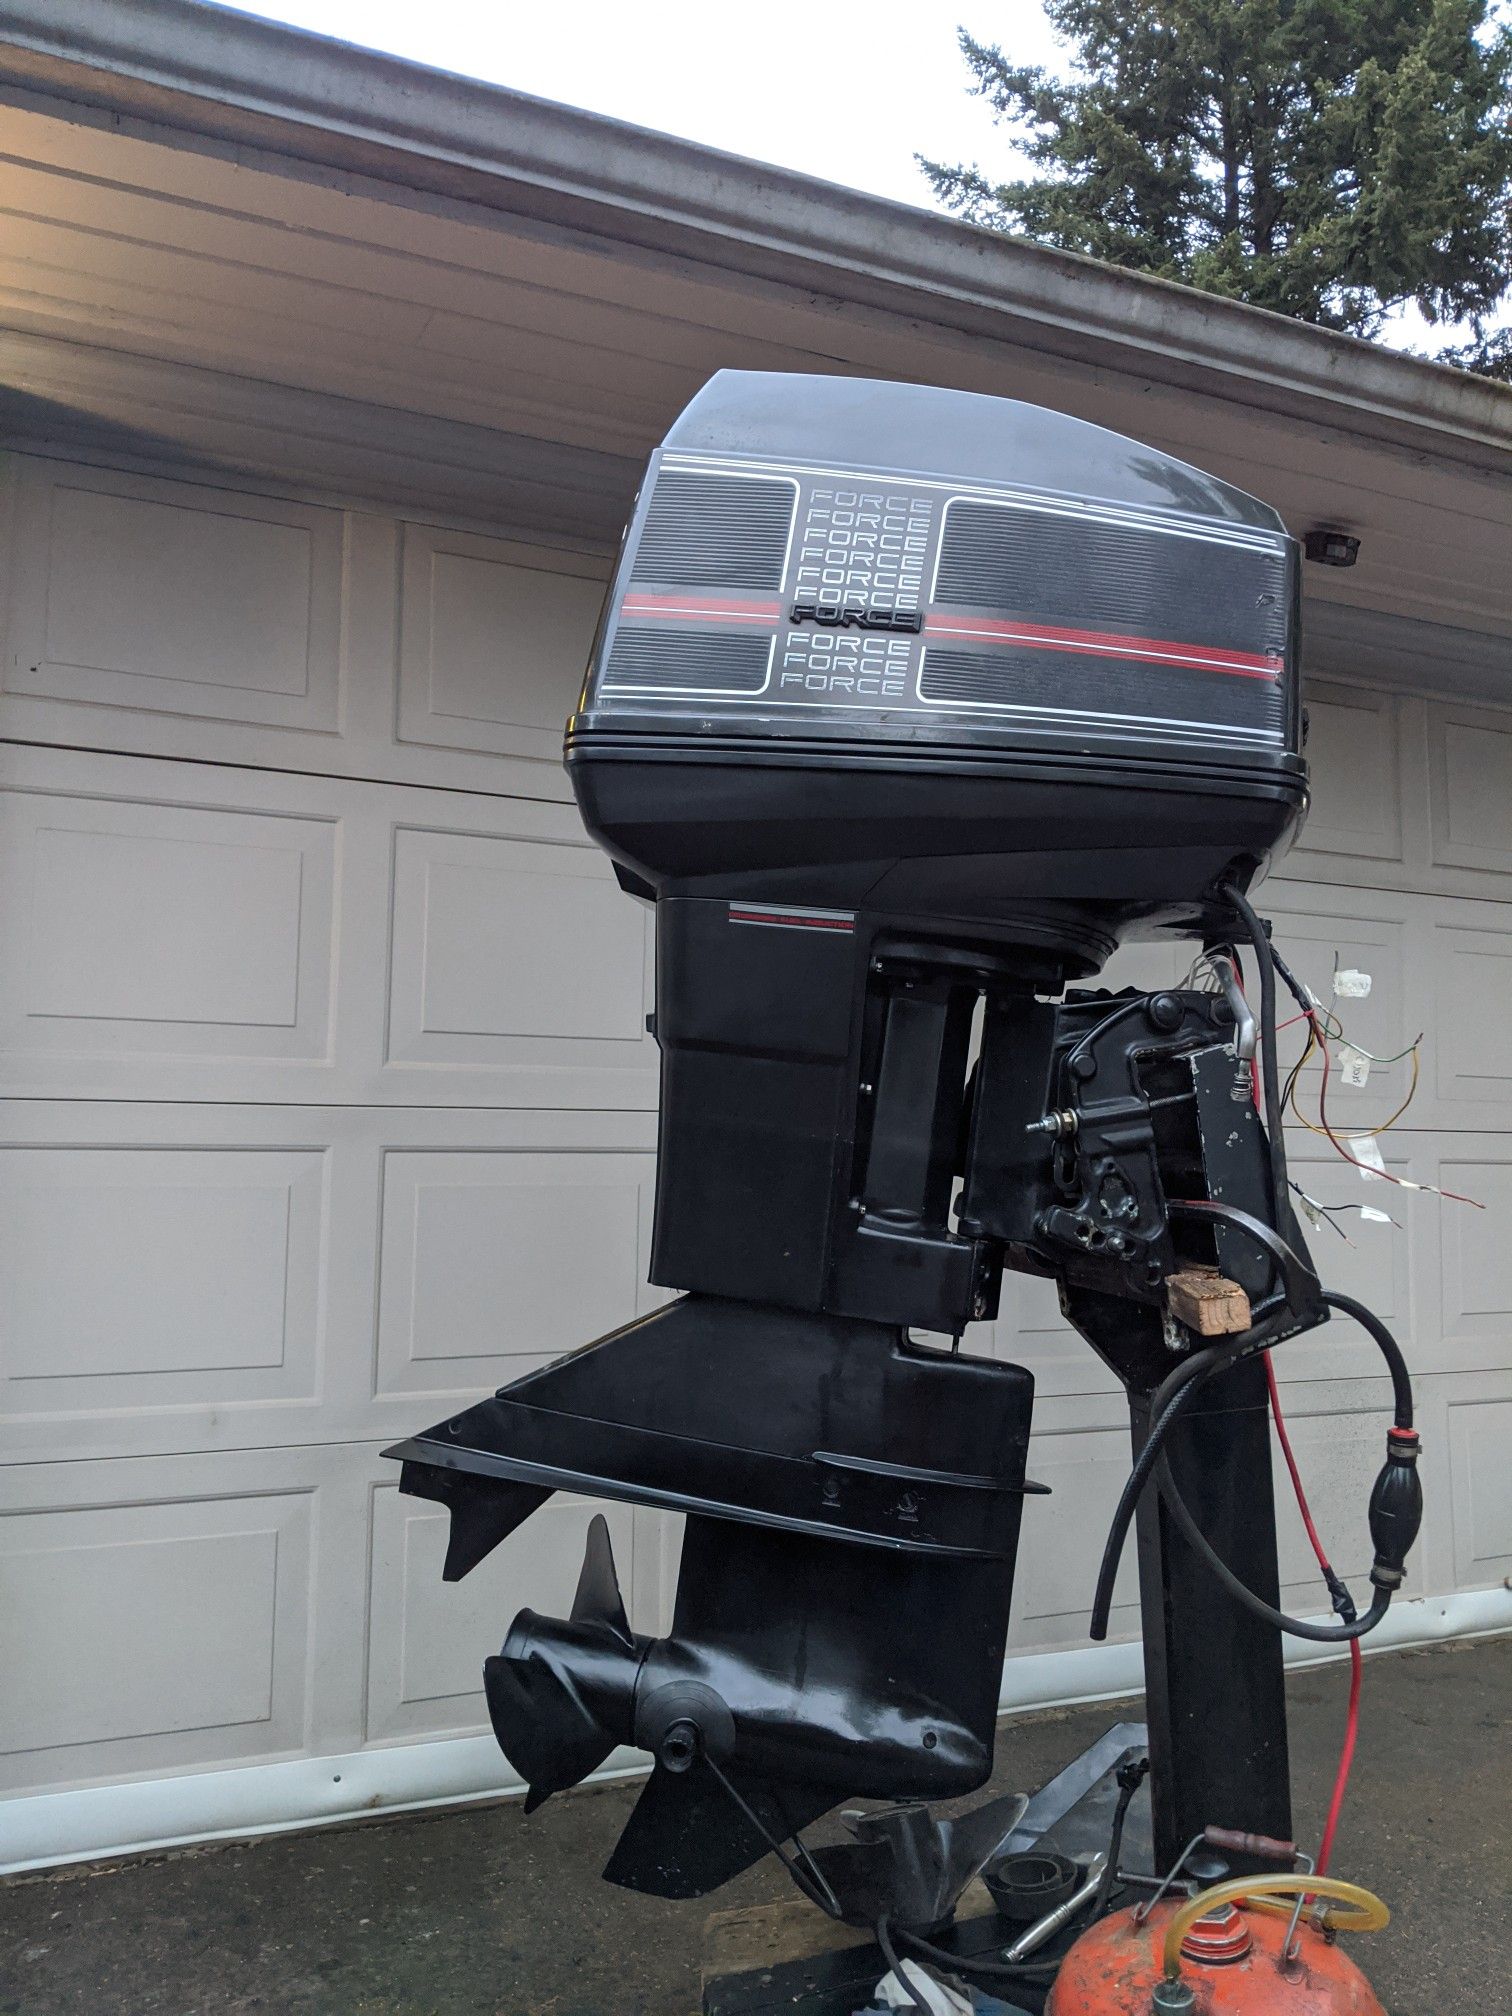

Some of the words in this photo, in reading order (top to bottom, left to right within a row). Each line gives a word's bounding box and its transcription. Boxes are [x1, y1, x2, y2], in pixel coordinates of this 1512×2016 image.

[810, 489, 933, 514] FORCE
[807, 509, 931, 533] FORCE
[804, 528, 928, 552] FORCE
[800, 547, 924, 571] FORCE
[797, 566, 922, 590] FORCE
[794, 586, 919, 610] FORCE
[790, 604, 923, 633] FORCE
[787, 632, 911, 656] FORCE
[783, 653, 908, 677] FORCE
[780, 672, 905, 696] FORCE
